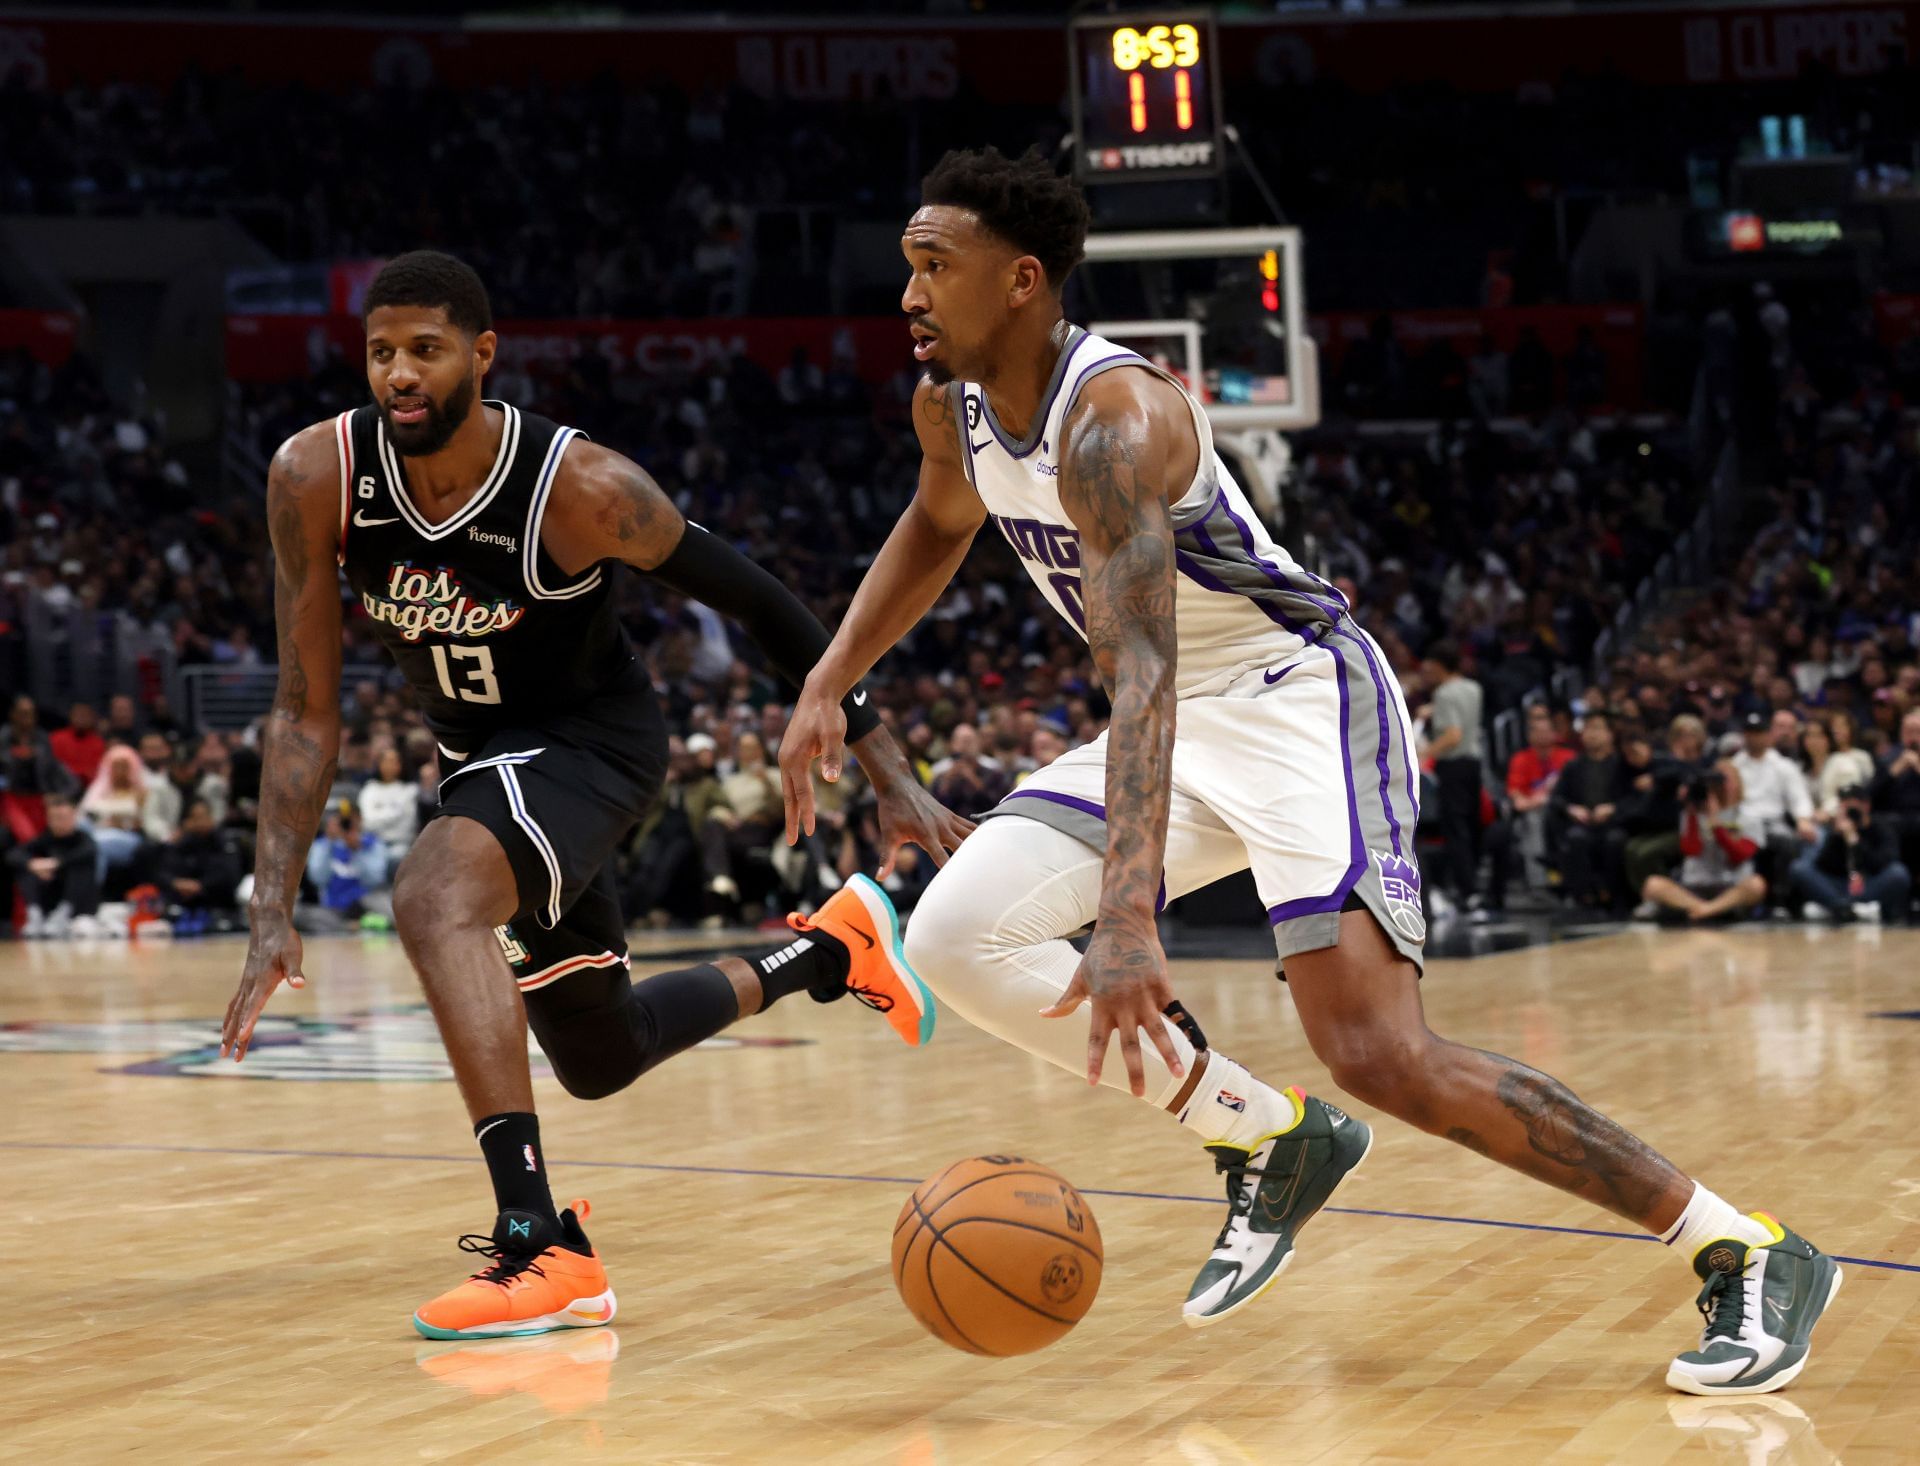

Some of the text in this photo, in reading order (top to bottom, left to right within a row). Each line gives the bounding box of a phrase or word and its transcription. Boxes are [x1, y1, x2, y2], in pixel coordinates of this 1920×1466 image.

[1112, 23, 1200, 71] 8:53
[1128, 69, 1193, 133] 11
[1121, 142, 1213, 168] TISSOT
[358, 476, 375, 499] 6
[467, 526, 518, 553] honey
[388, 565, 461, 602] los
[362, 592, 521, 641] angeles
[430, 644, 502, 704] 13
